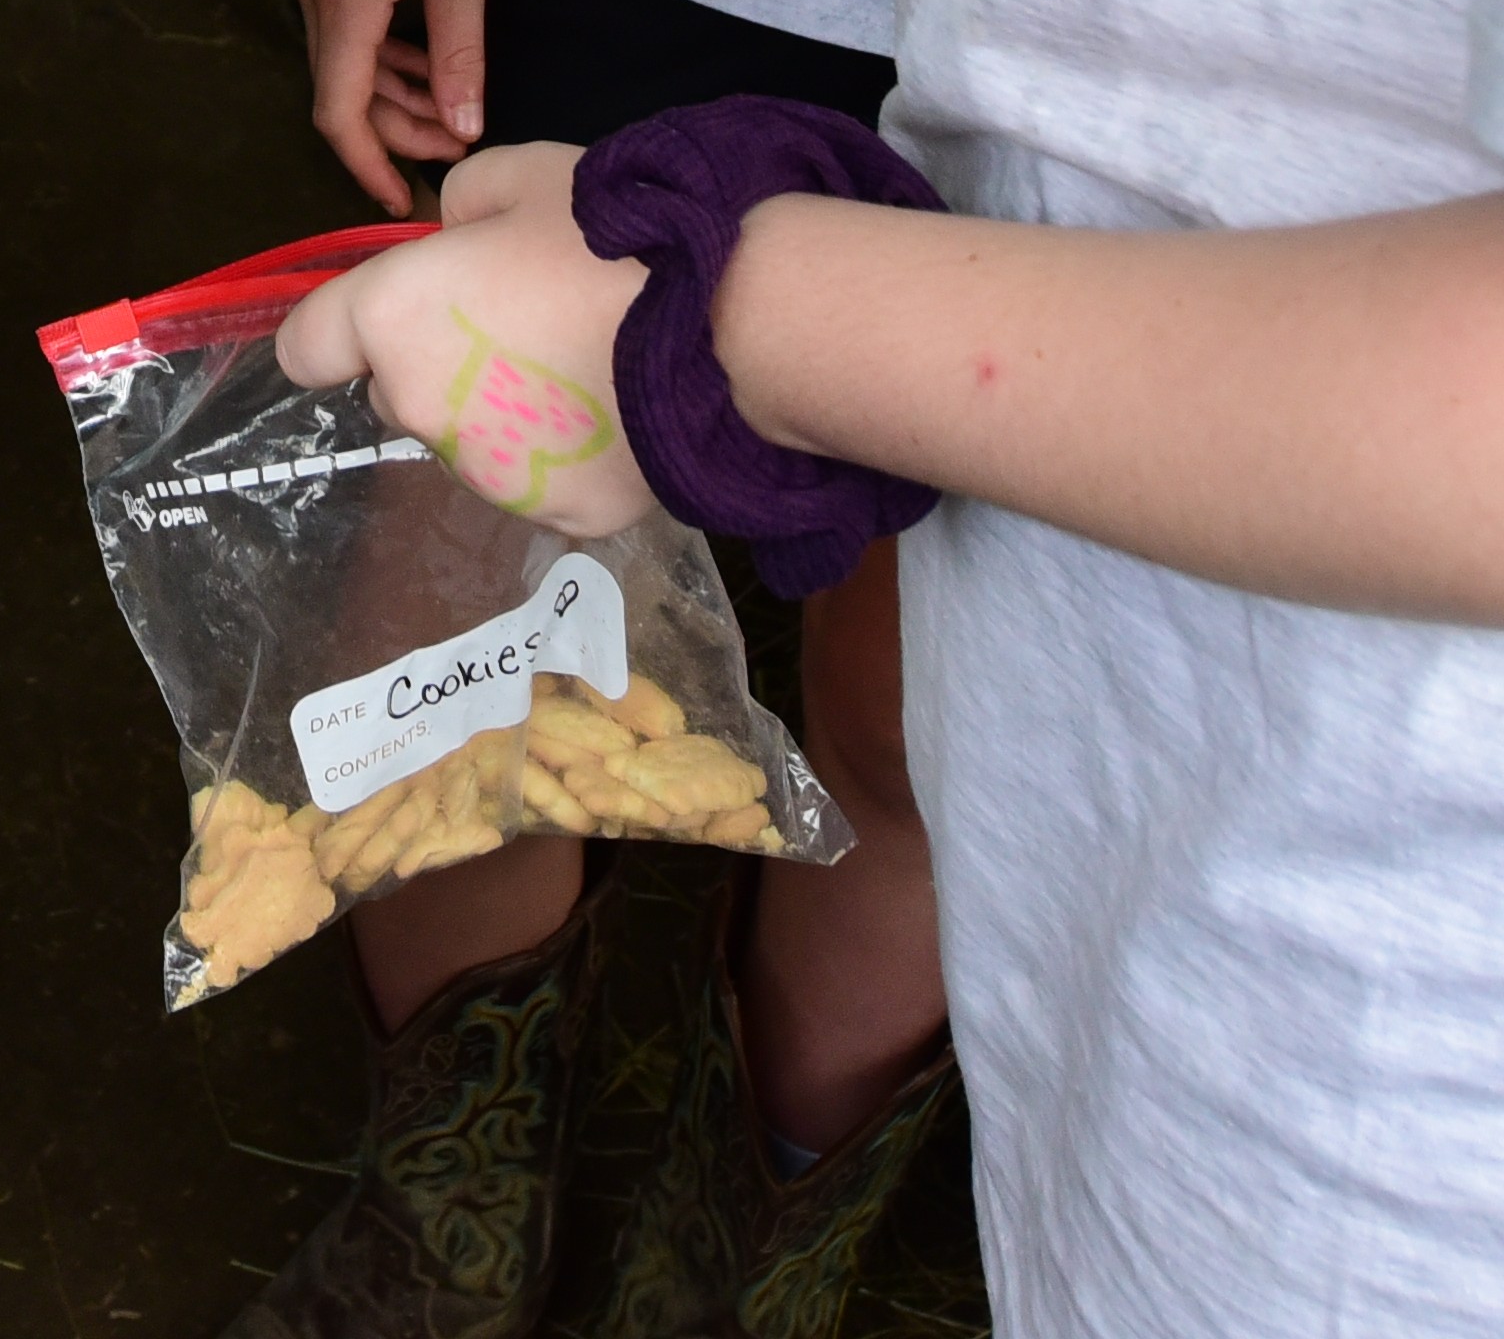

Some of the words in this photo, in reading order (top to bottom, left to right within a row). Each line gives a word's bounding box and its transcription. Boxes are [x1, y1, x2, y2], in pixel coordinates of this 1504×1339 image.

[159, 505, 209, 528] OPEN
[309, 702, 366, 734] DATE
[324, 721, 428, 783] CONTENTS
